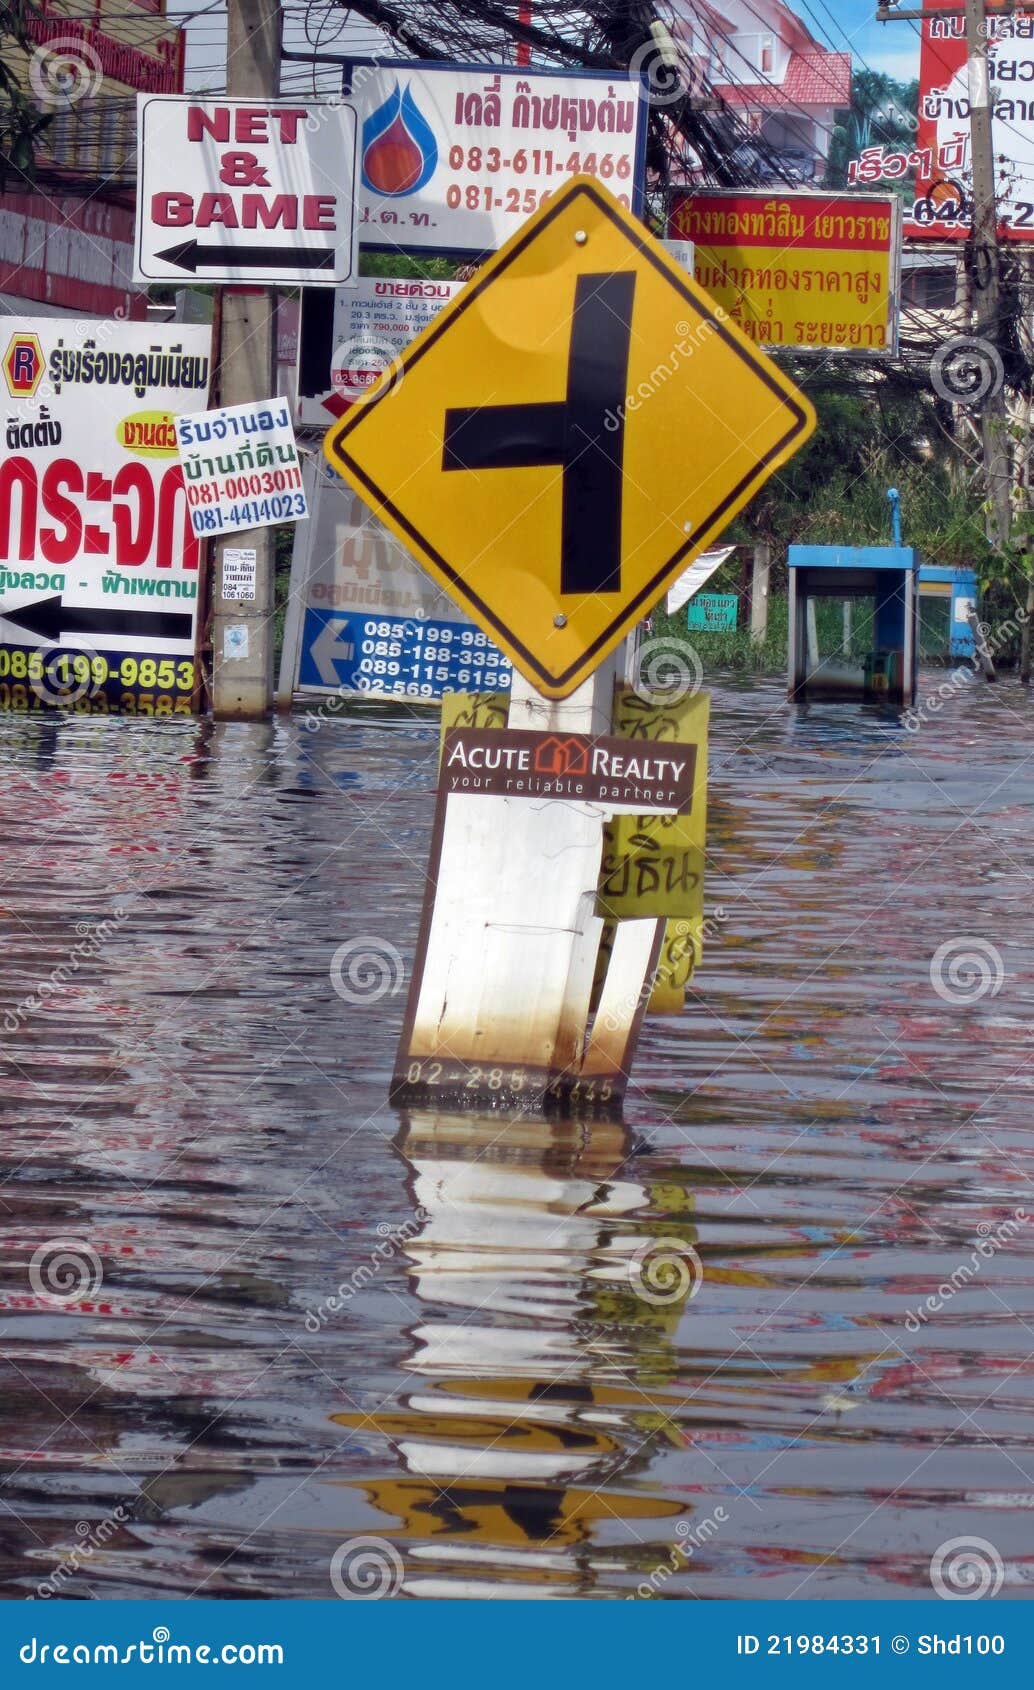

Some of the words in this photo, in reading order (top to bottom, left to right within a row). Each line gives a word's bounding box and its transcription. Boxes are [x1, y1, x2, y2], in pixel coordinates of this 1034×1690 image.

[454, 75, 501, 127] เดลี่
[187, 106, 308, 145] NET
[219, 151, 272, 187] &
[449, 145, 631, 180] 083-611-4466
[151, 191, 338, 231] GAME
[814, 214, 890, 241] เยาวราช
[375, 282, 451, 298] ขายด่วน
[396, 302, 403, 310] 2
[793, 321, 886, 346] ระยะยาว
[15, 346, 34, 382] R
[6, 404, 62, 450] ติดตั้ง
[123, 416, 178, 446] งานด่ว
[178, 408, 290, 446] รับจำนอง
[183, 439, 297, 480] บ้านที่ดิน
[187, 467, 302, 507] 081-0003011
[0, 456, 199, 570] กระจก
[192, 493, 307, 532] 081-4414023
[223, 583, 237, 592] 084
[0, 650, 195, 691] 085-199-9853
[361, 639, 513, 669] 085-188-3354
[360, 658, 511, 688] 089-115-6159
[451, 776, 493, 790] your
[506, 777, 584, 794] reliable
[599, 781, 676, 801] partner
